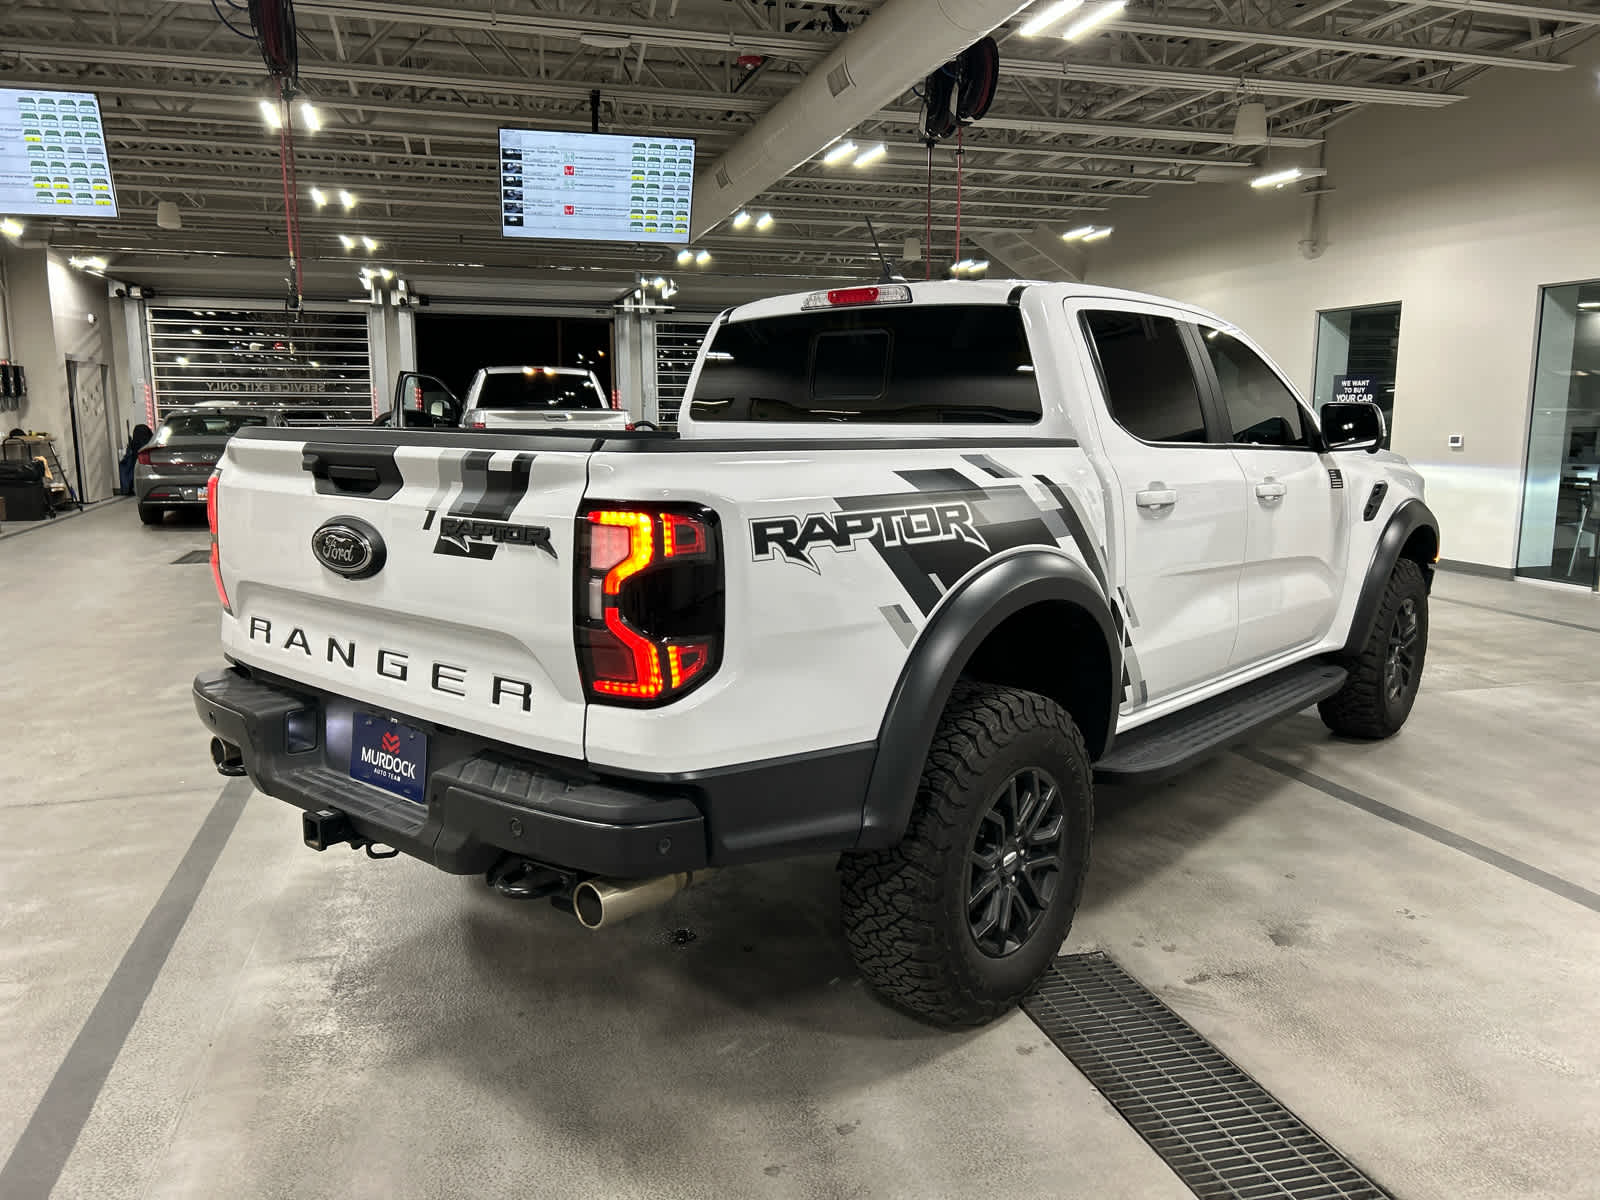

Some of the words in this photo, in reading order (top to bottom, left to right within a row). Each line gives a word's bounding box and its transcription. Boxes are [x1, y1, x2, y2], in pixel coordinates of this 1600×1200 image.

[1336, 394, 1356, 402] YOUR
[1357, 394, 1373, 402] CAR
[322, 534, 355, 563] Ford
[440, 516, 559, 560] RAPTOR
[748, 501, 992, 576] RAPTOR
[250, 616, 533, 712] RANGER
[361, 745, 416, 780] MURDOCK
[374, 768, 387, 777] AUTO
[388, 772, 401, 781] TEAM
